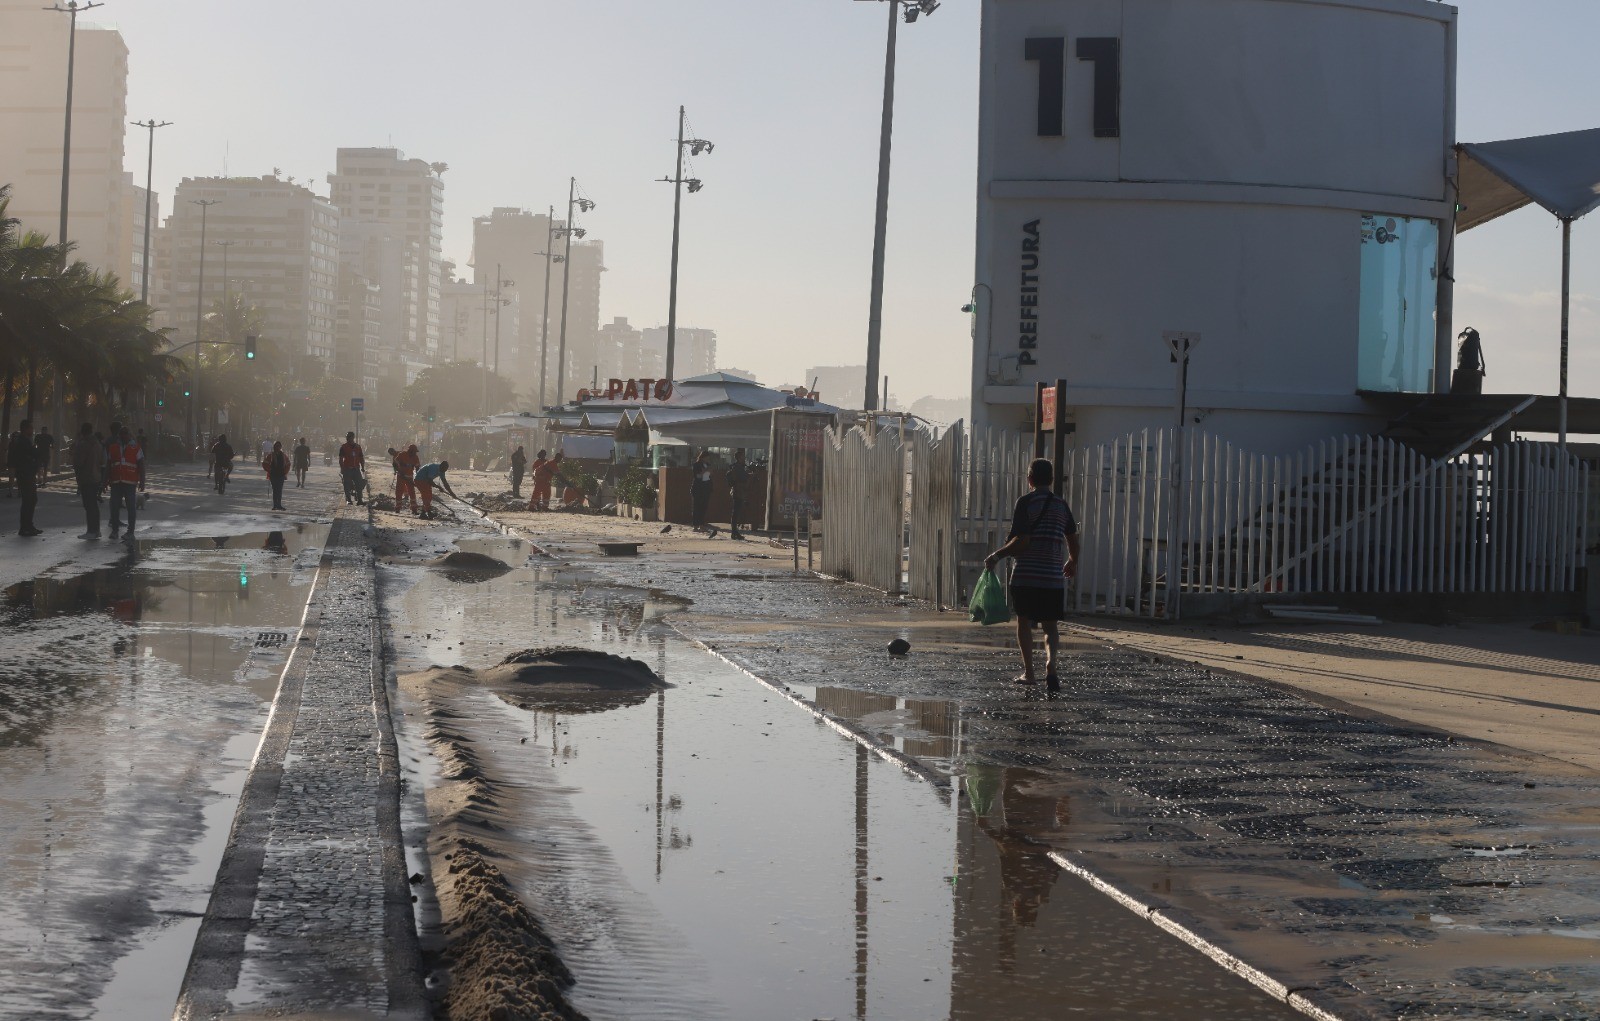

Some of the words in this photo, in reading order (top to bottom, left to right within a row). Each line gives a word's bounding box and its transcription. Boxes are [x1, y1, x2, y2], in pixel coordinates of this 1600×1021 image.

[1025, 37, 1120, 138] 11
[1018, 218, 1041, 366] PREFEITURA
[608, 378, 674, 401] PATO
